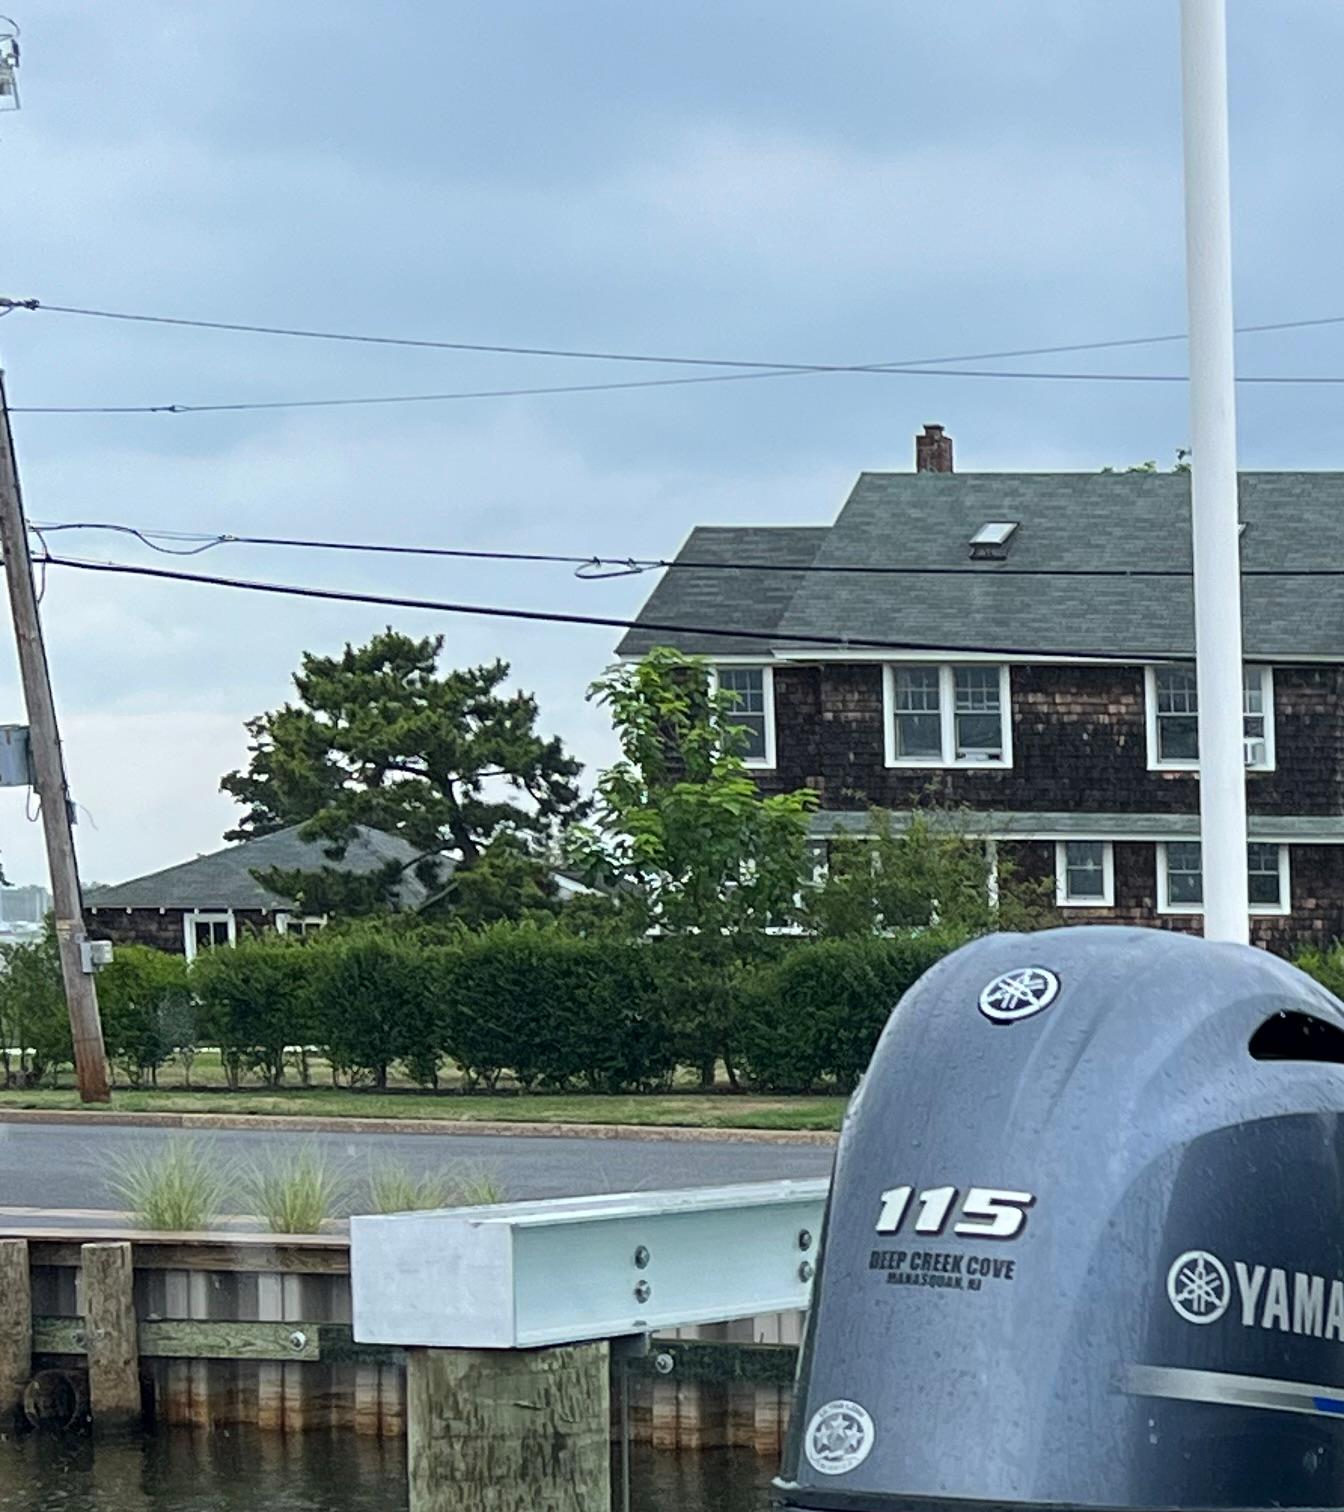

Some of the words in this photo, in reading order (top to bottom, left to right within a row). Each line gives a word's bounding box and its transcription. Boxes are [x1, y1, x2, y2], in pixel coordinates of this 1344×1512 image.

[875, 1185, 1036, 1240] 115
[869, 1250, 908, 1270] DEEP
[909, 1252, 964, 1274] CREEK
[966, 1256, 1016, 1280] COVE
[967, 1278, 982, 1291] NJ
